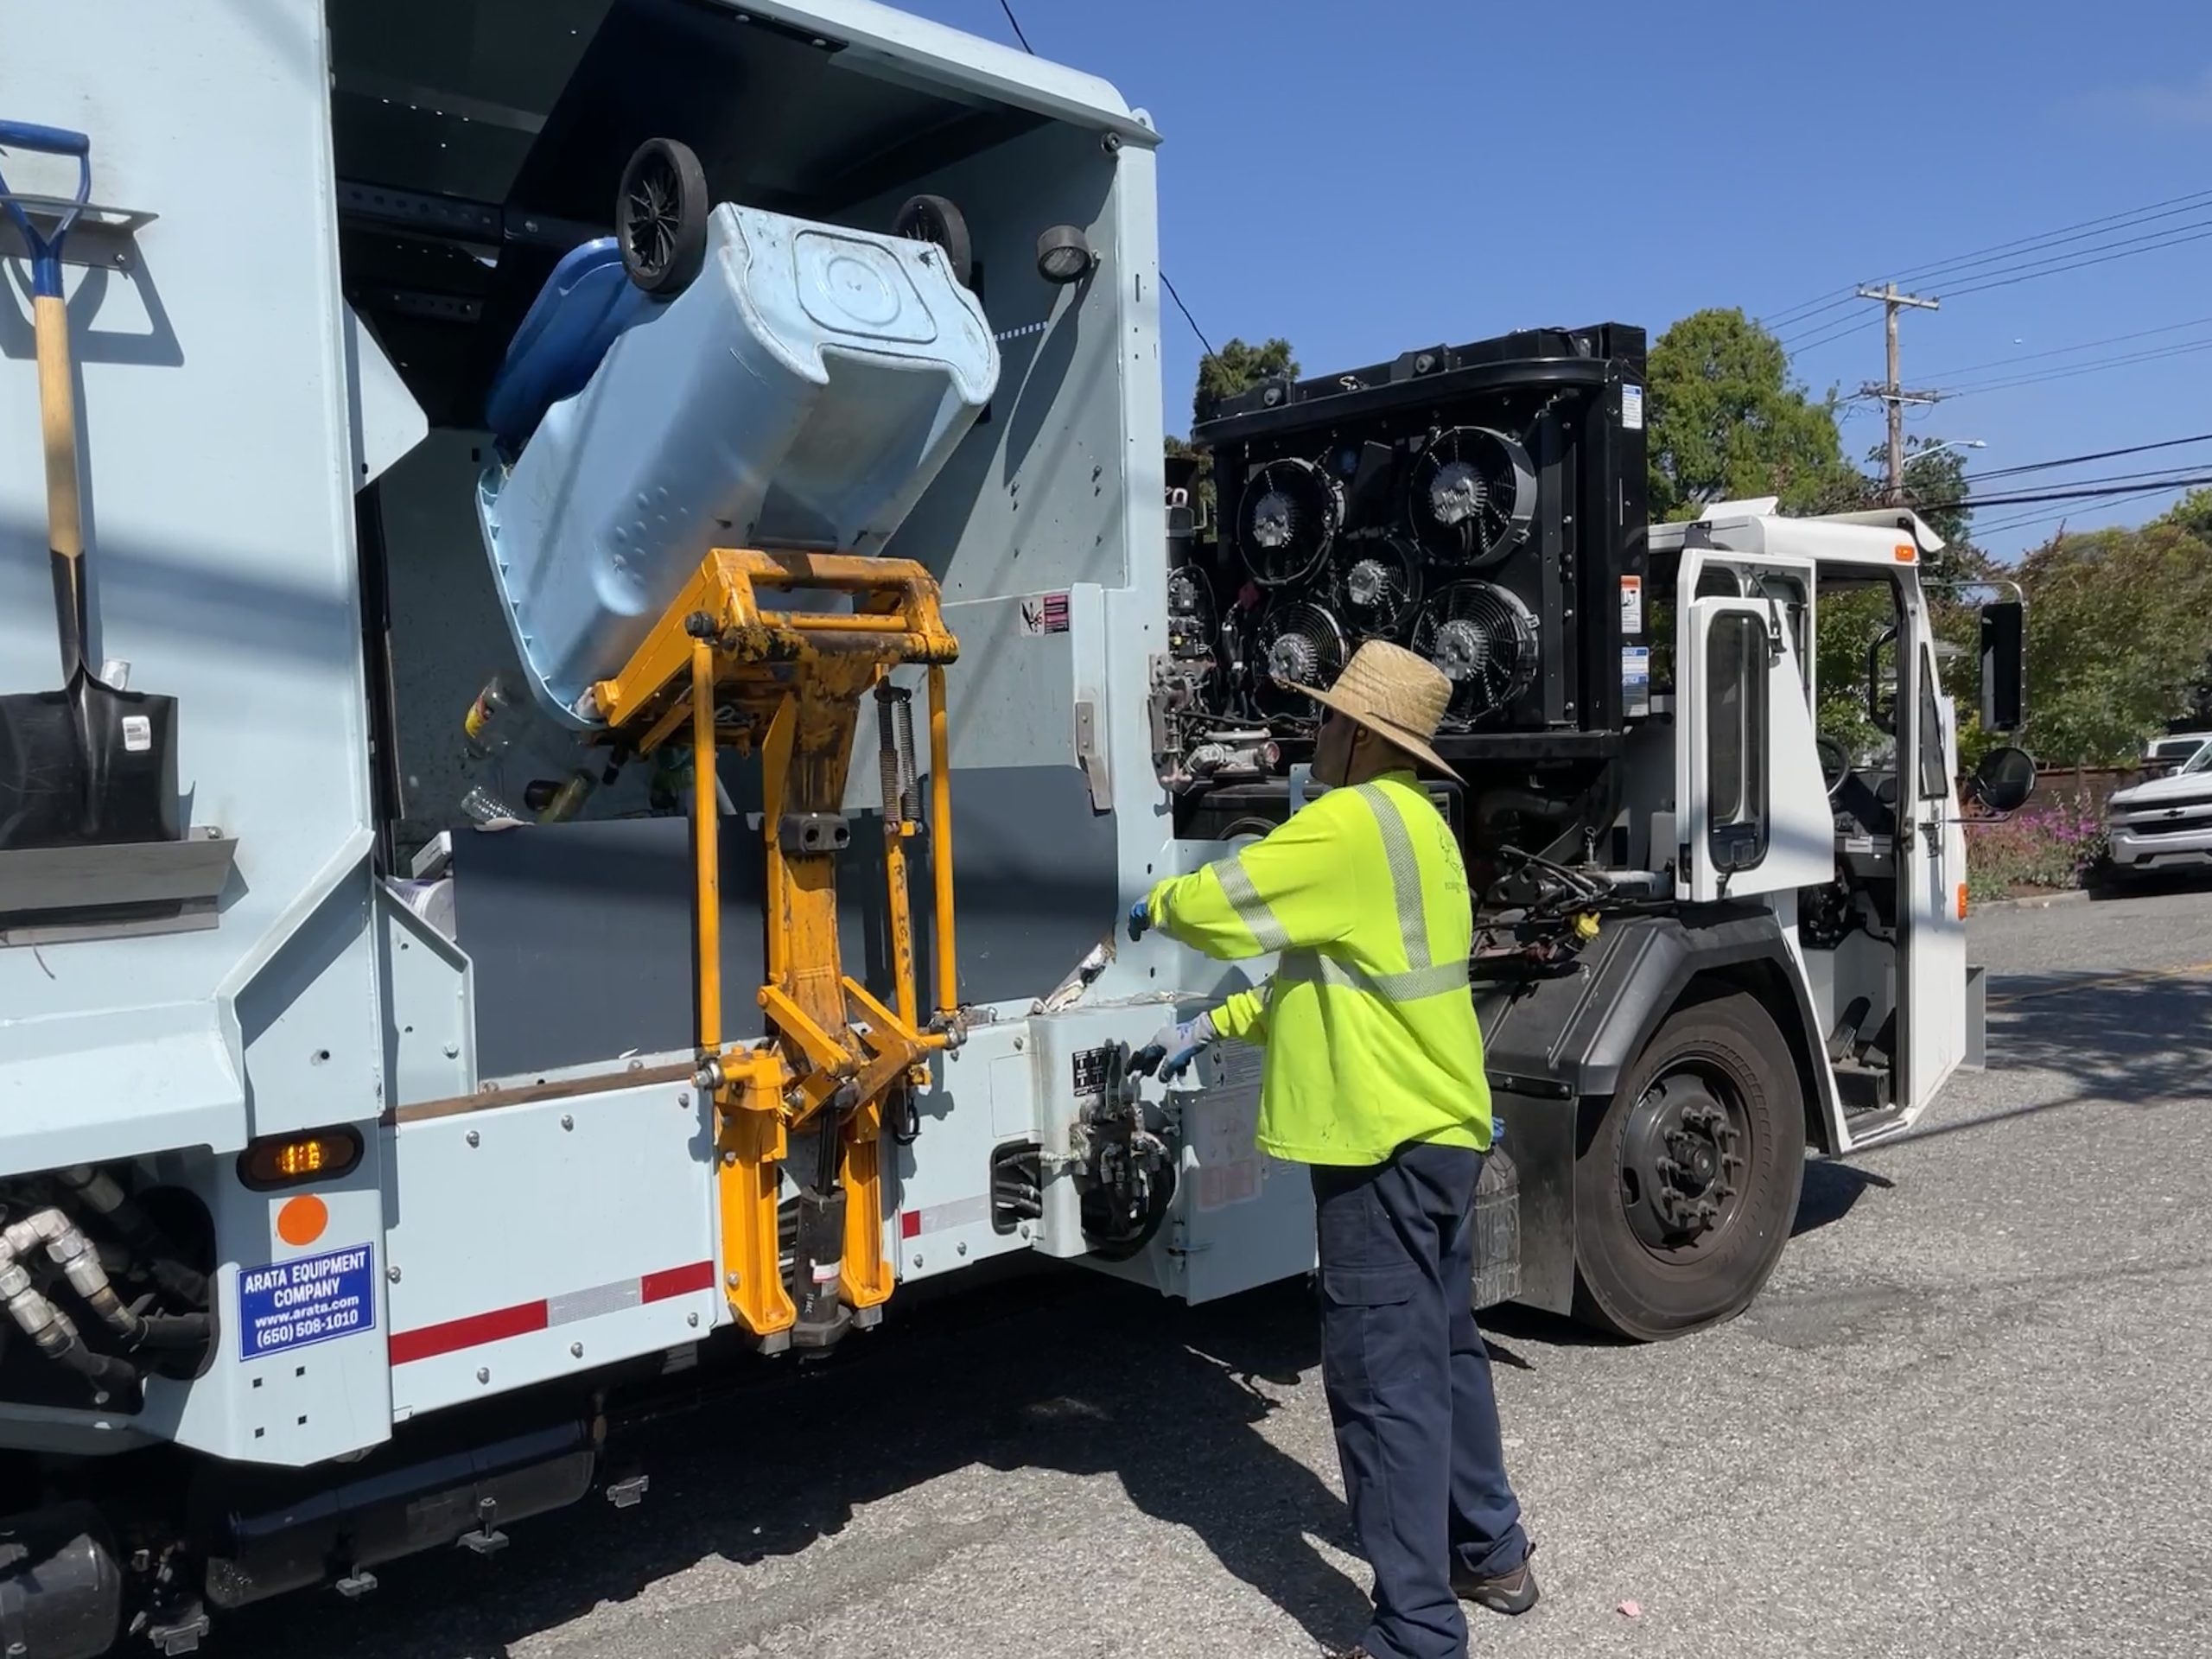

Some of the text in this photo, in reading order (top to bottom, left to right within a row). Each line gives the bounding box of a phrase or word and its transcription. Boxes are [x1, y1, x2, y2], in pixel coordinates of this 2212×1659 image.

[245, 1251, 366, 1294] ARATA EQUIPMENT
[274, 1277, 340, 1308] COMPANY
[254, 1295, 359, 1328] www.arata.com
[257, 1309, 359, 1348] (650) 508-1010
